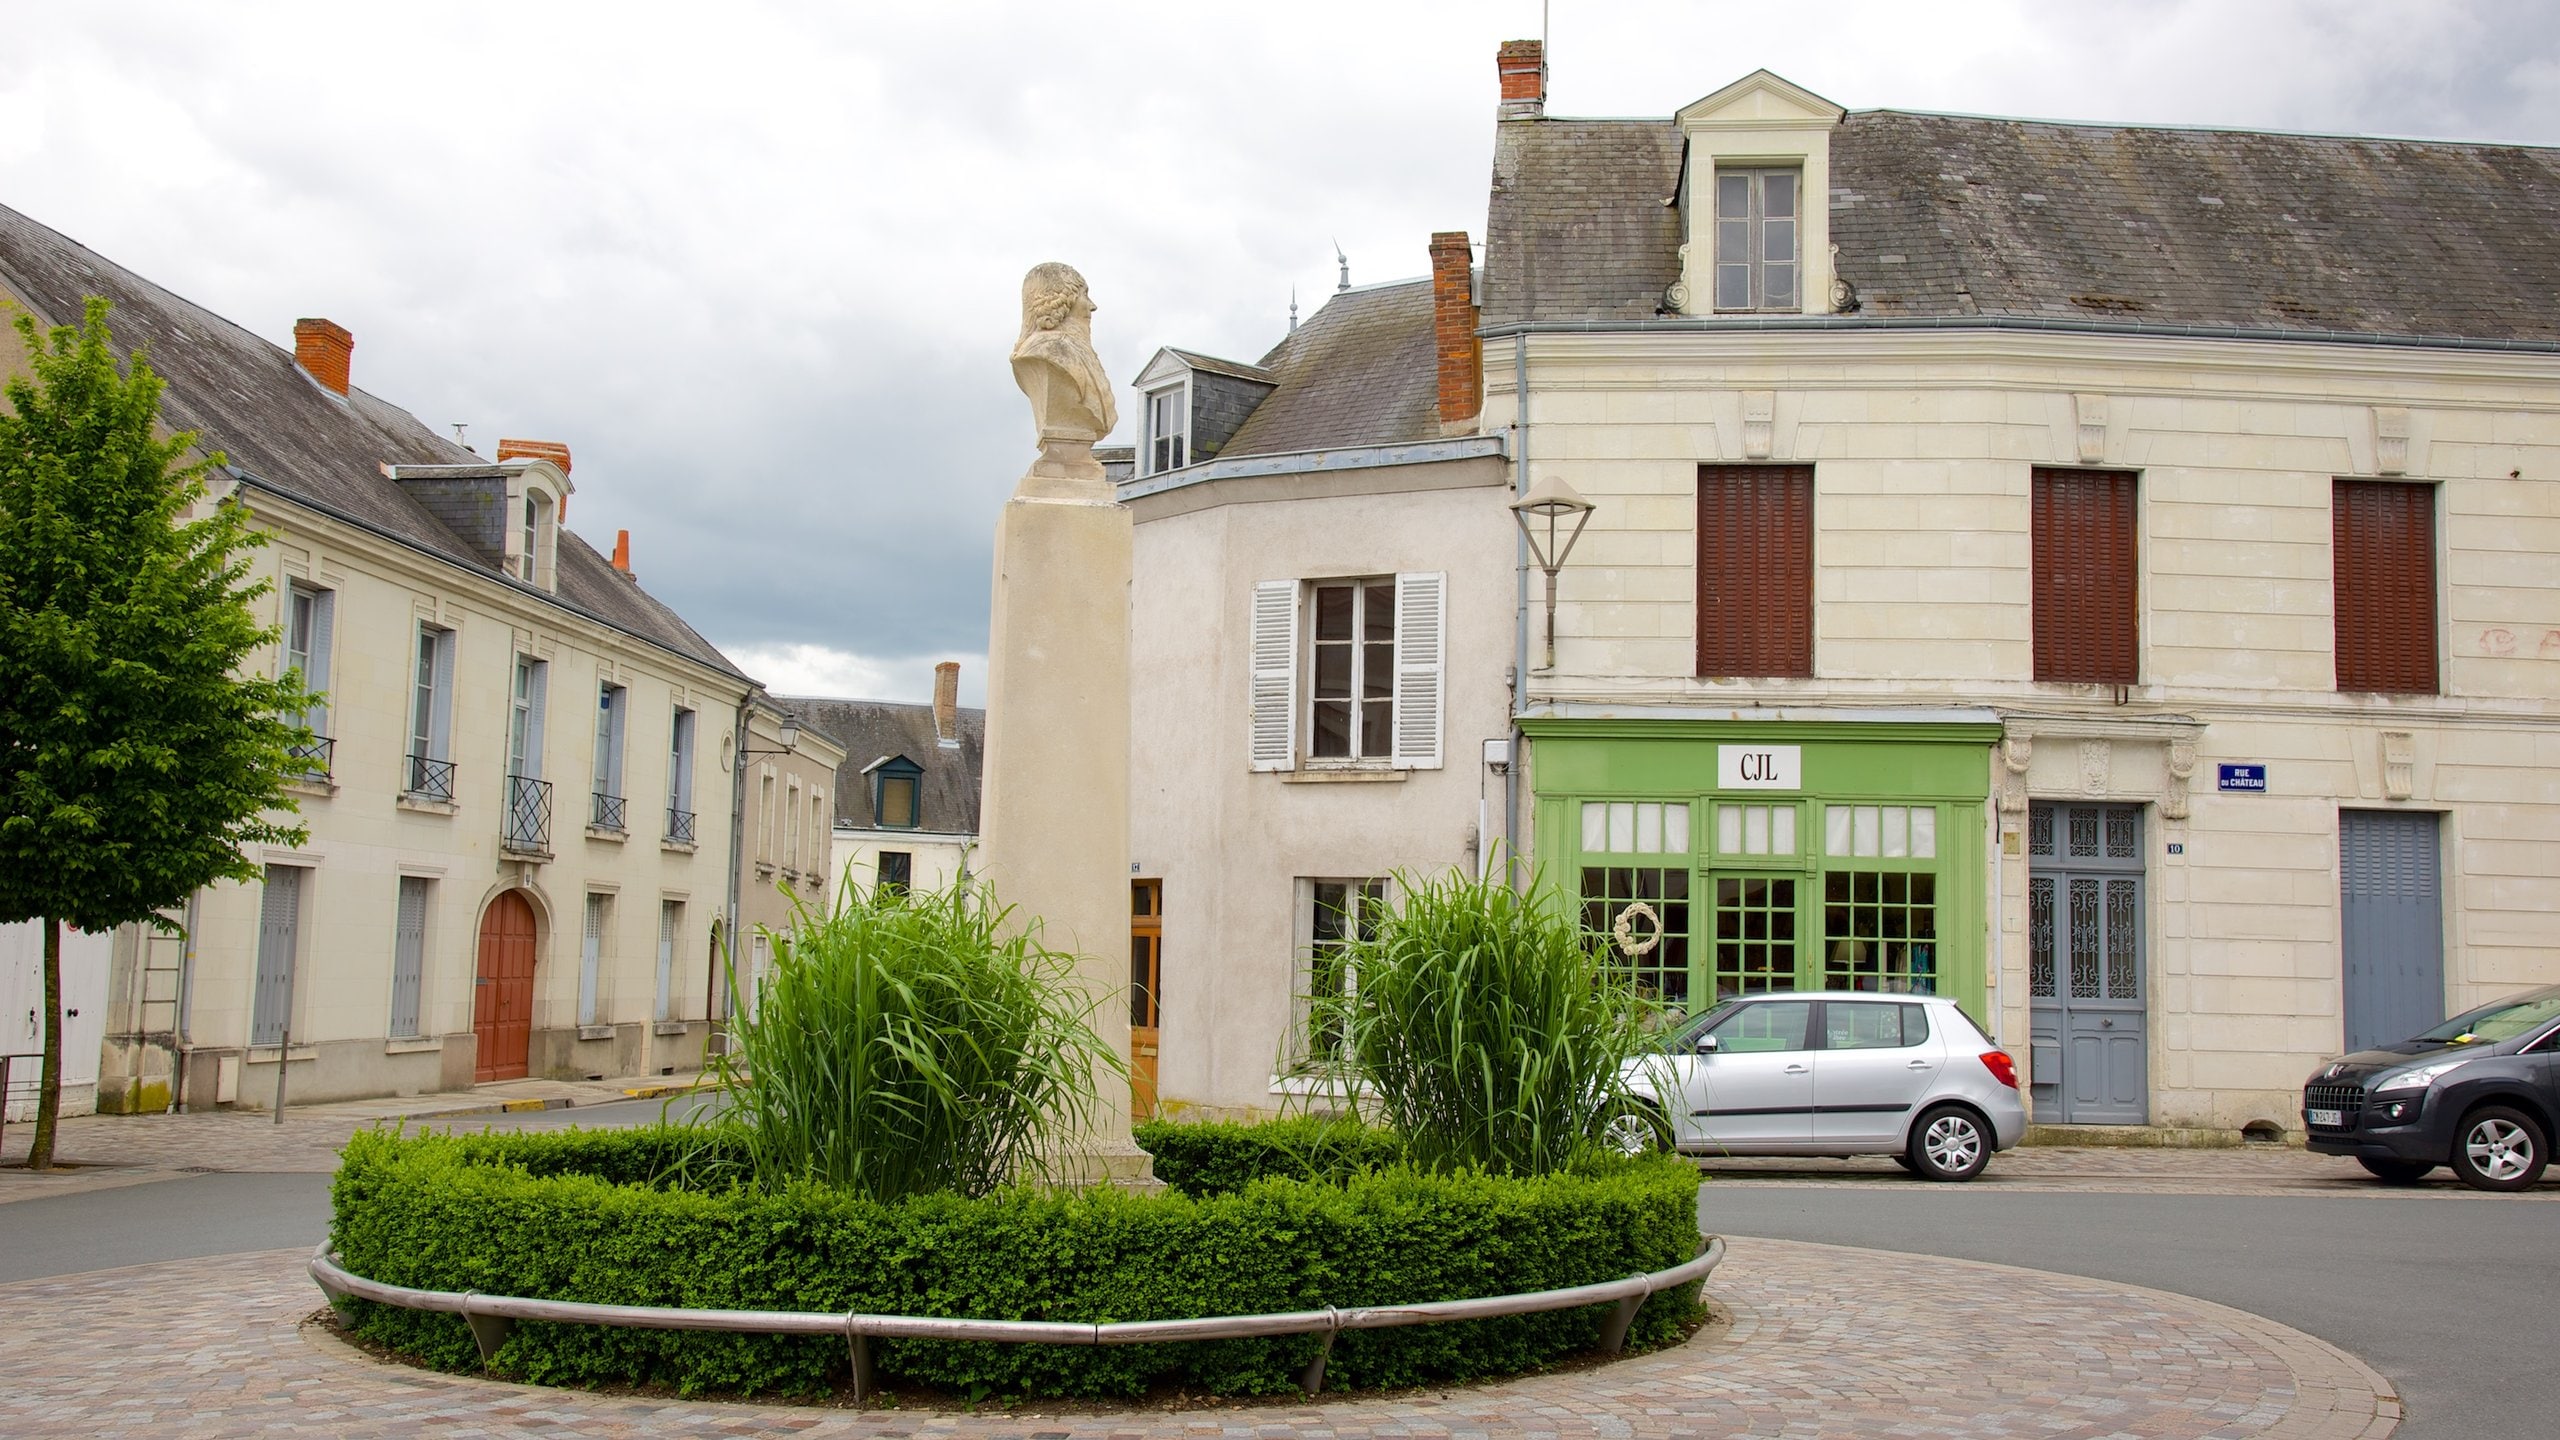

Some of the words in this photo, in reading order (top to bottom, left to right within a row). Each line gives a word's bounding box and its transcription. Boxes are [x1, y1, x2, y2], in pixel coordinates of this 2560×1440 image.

[1740, 753, 1778, 781] CJL
[2234, 768, 2250, 777] RUE
[2230, 777, 2264, 787] CHÂTEAU
[2170, 845, 2181, 853] 10
